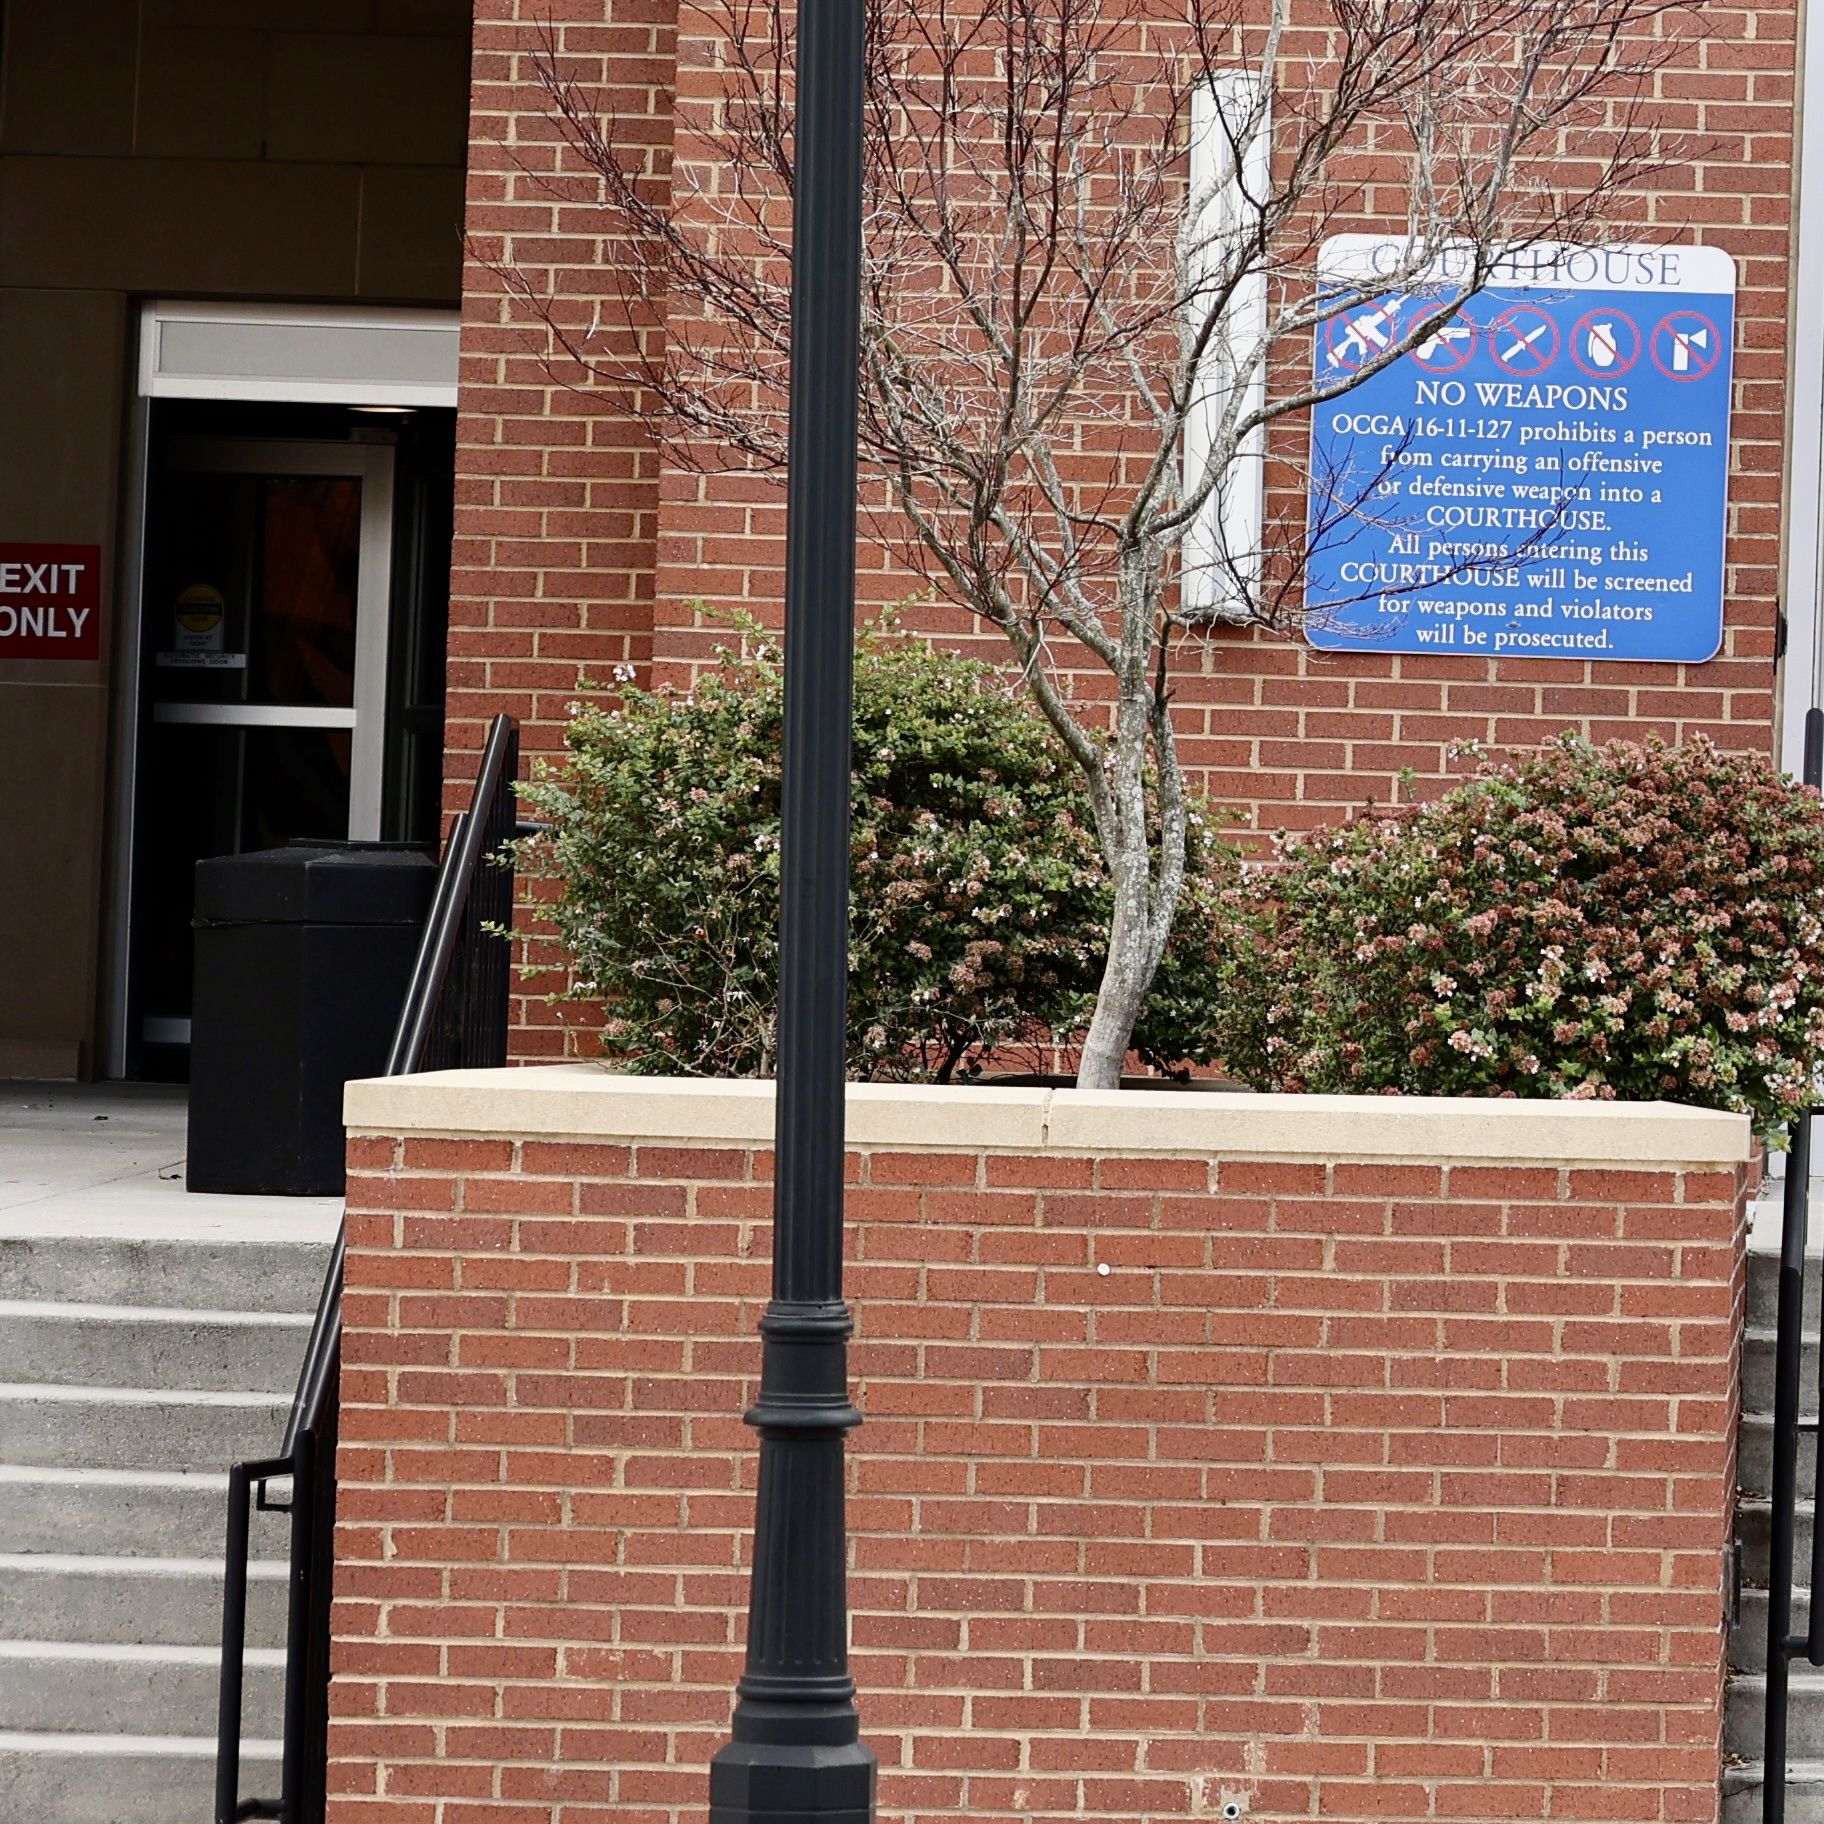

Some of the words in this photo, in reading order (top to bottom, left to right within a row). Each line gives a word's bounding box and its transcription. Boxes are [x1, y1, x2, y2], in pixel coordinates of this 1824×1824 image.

[1415, 381, 1466, 406] NO
[1474, 383, 1628, 412] WEAPONS
[1332, 414, 1406, 435] OCGA
[1415, 417, 1512, 439] 16-11-127
[1519, 420, 1615, 445] prohibits
[1624, 429, 1635, 443] a
[1643, 428, 1713, 450] person
[1381, 444, 1432, 466] from
[1441, 449, 1528, 473] carrying
[1535, 454, 1561, 470] an
[1568, 451, 1663, 473] offensive
[1378, 480, 1401, 495] or
[1409, 476, 1505, 499] defensive
[1511, 482, 1592, 508] weapon
[1600, 482, 1643, 502] into
[1651, 488, 1662, 502] a
[1426, 506, 1612, 531] COURTHOUSE.
[1388, 533, 1420, 555] All
[1428, 539, 1508, 562] persons
[1516, 541, 1602, 565] entering
[1610, 541, 1648, 561] this
[0, 563, 85, 595] EXIT
[1340, 562, 1521, 588] COURTHOUSE
[1526, 567, 1566, 590] will
[1574, 568, 1598, 591] be
[1604, 572, 1693, 593] screened
[0, 606, 91, 638] ONLY
[1379, 593, 1411, 613] for
[1418, 597, 1507, 622] weapons
[1514, 596, 1553, 619] and
[1560, 598, 1653, 622] violators
[1416, 624, 1455, 645] will
[1463, 624, 1487, 646] be
[1494, 628, 1614, 652] prosecuted.
